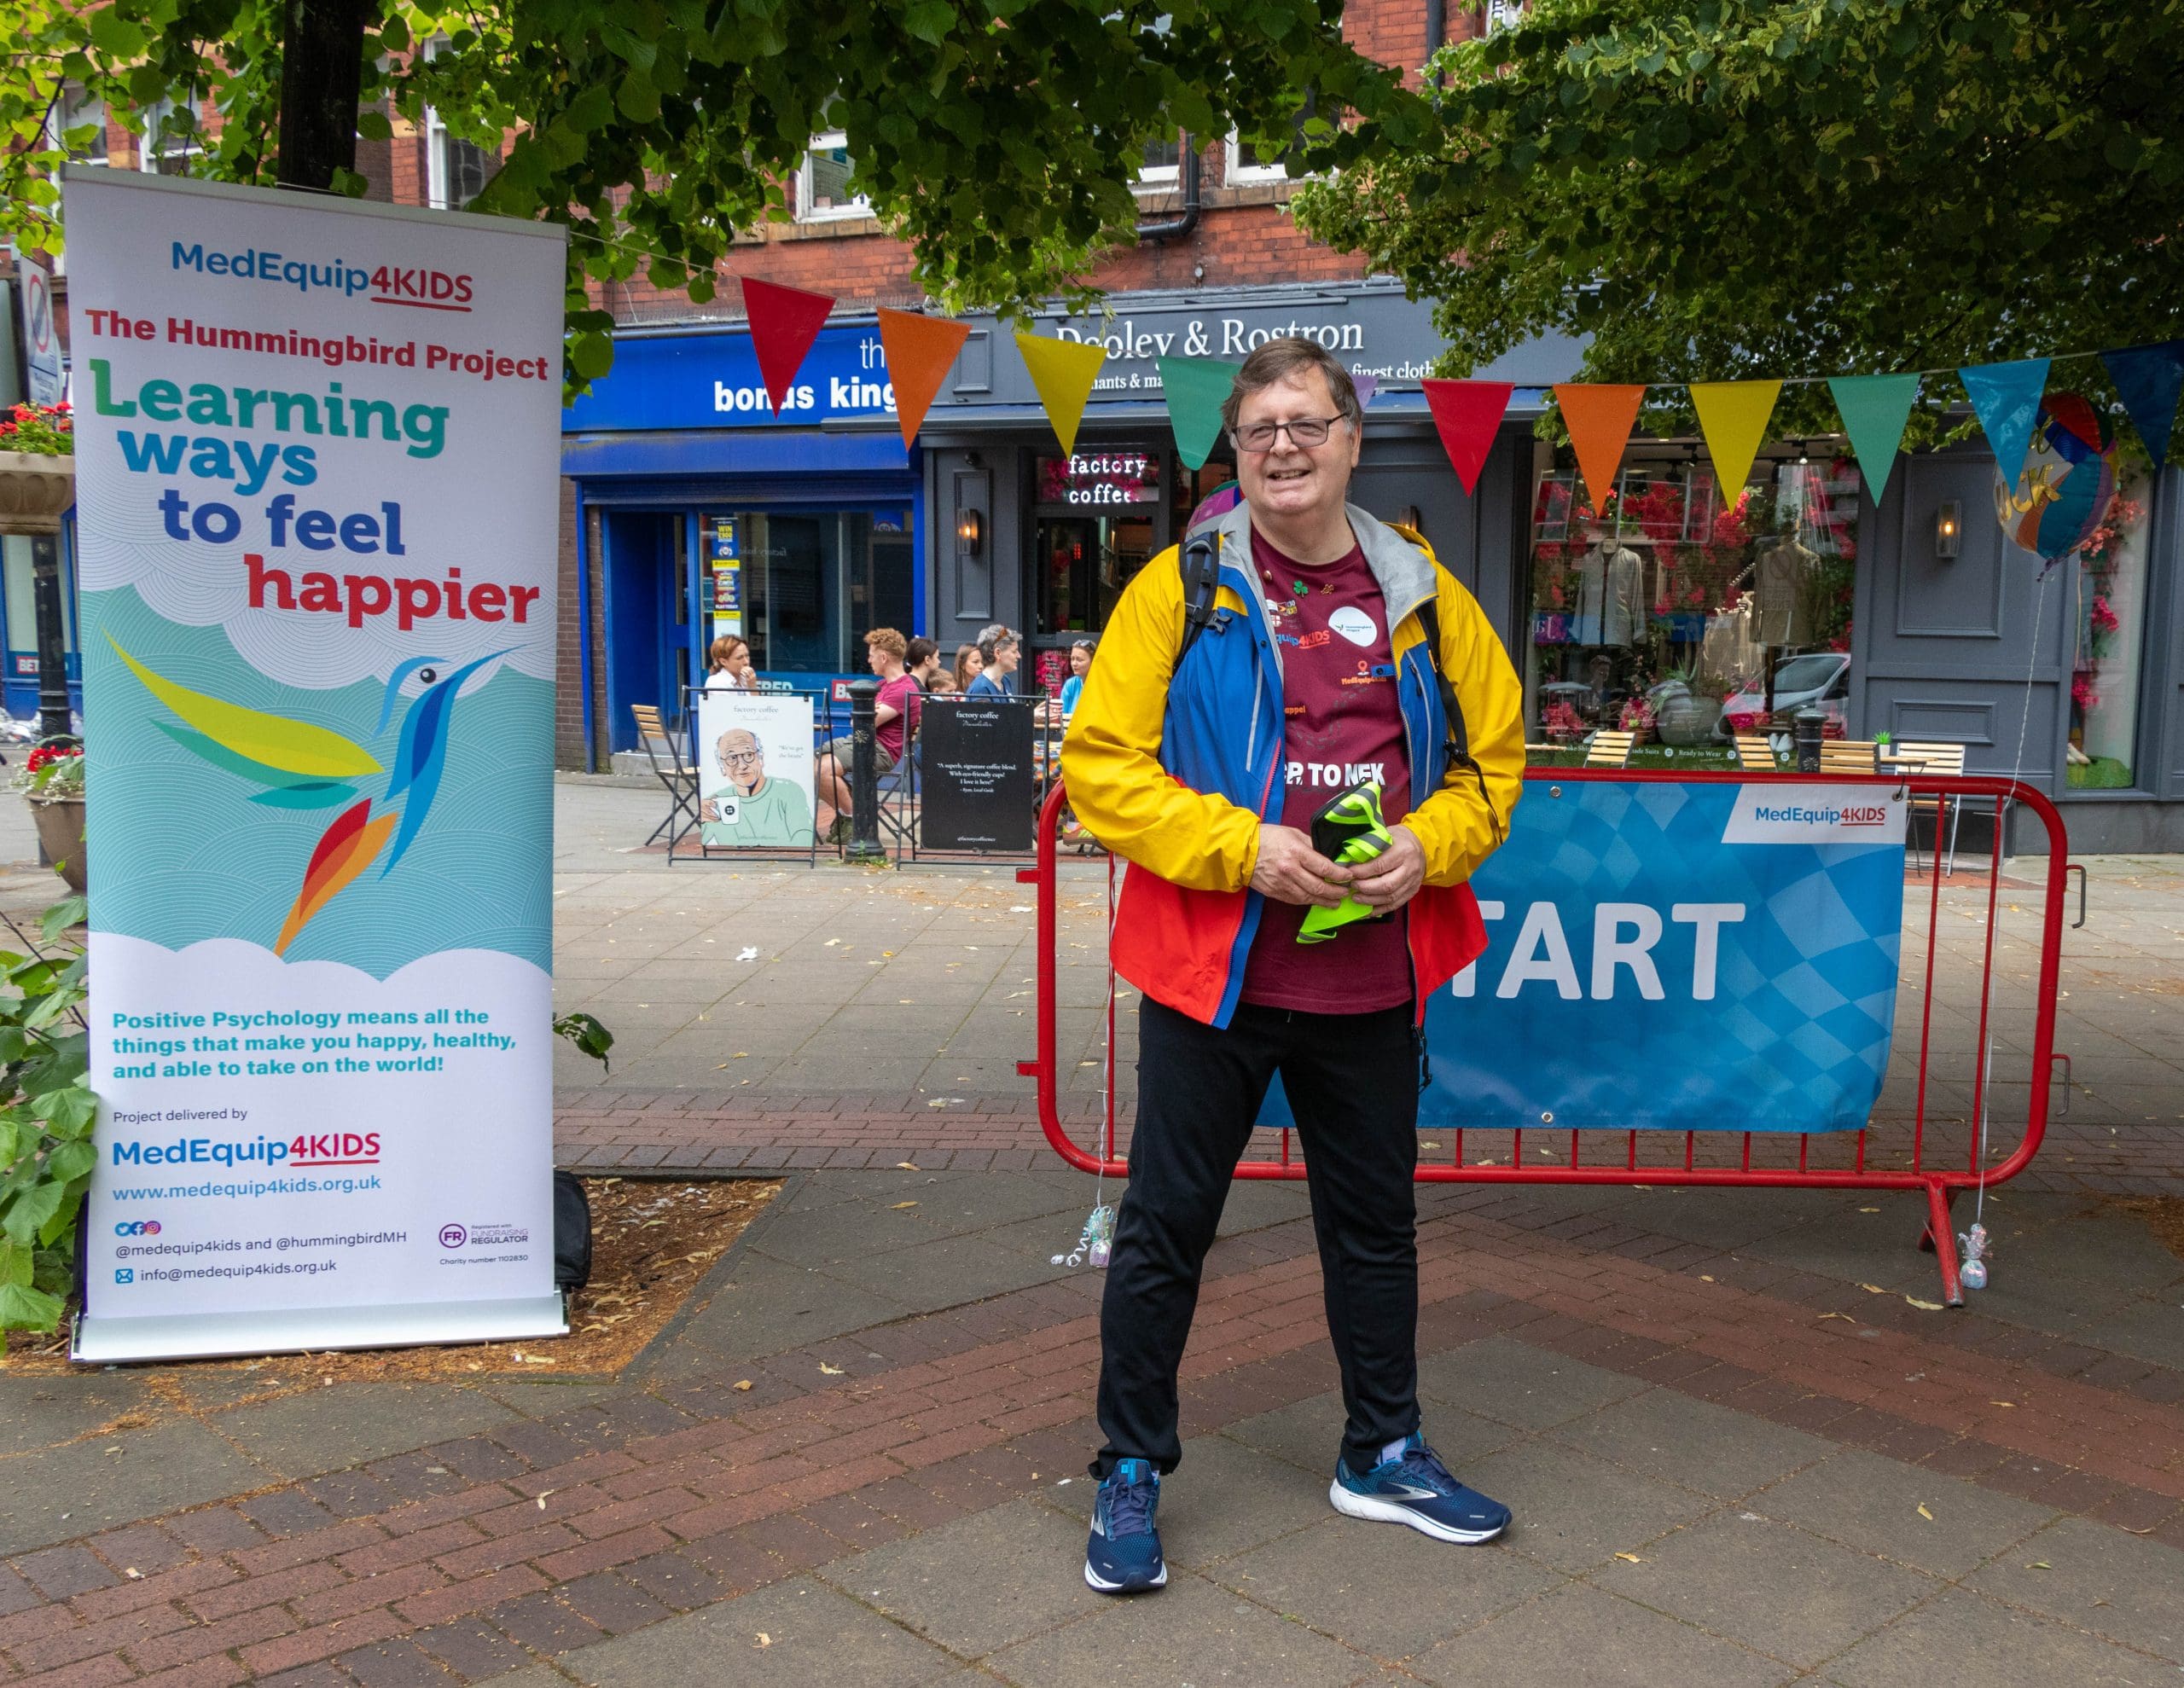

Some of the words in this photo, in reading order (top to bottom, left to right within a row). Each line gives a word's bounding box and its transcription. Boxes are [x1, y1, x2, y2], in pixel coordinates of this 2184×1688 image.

[172, 242, 473, 303] MedEquip4KIDS
[85, 309, 155, 339] The
[167, 317, 415, 366] Hummingbird
[427, 345, 548, 380] Project
[1184, 322, 1208, 357] &
[1222, 319, 1363, 355] Rostron
[860, 337, 885, 369] th
[1130, 373, 1141, 388] &
[1352, 363, 1393, 377] finest
[714, 381, 815, 411] bonus
[90, 359, 449, 459] Learning
[118, 431, 317, 496] ways
[1069, 455, 1147, 478] factory
[1069, 484, 1134, 503] coffee
[159, 490, 241, 543] to
[265, 494, 405, 555] feel
[244, 554, 539, 630] happier
[956, 711, 978, 720] factory
[1679, 749, 1696, 757] Ready
[1285, 762, 1304, 785] R
[1308, 763, 1341, 786] TO
[1755, 806, 1885, 825] MedEquip4KIDS
[113, 1011, 205, 1029] Positive
[213, 1008, 341, 1031] Psychology
[348, 1011, 419, 1024] means
[424, 1008, 449, 1024] all
[455, 1008, 490, 1024] the
[113, 1036, 187, 1057] things
[193, 1035, 239, 1053] that
[245, 1034, 305, 1051] make
[312, 1037, 350, 1053] you
[357, 1033, 427, 1053] happy,
[433, 1031, 516, 1051] healthy,
[113, 1061, 157, 1079] and
[163, 1059, 212, 1078] able
[218, 1061, 241, 1076] to
[247, 1059, 295, 1075] take
[302, 1059, 329, 1073] on
[335, 1056, 370, 1073] the
[376, 1056, 444, 1072] world!
[113, 1109, 162, 1125] Project
[166, 1108, 228, 1122] delivered
[230, 1108, 247, 1122] by
[113, 1133, 380, 1167] MedEquip4KIDS
[113, 1175, 382, 1201] www.medequip4kids.org.uk
[115, 1238, 241, 1259] @medequip4kids
[246, 1238, 272, 1252] and
[276, 1230, 407, 1250] @hummingbirdMH
[444, 1232, 462, 1241] FR
[471, 1236, 528, 1244] REGULATOR
[140, 1259, 337, 1281] info@medequip4kids.org.uk
